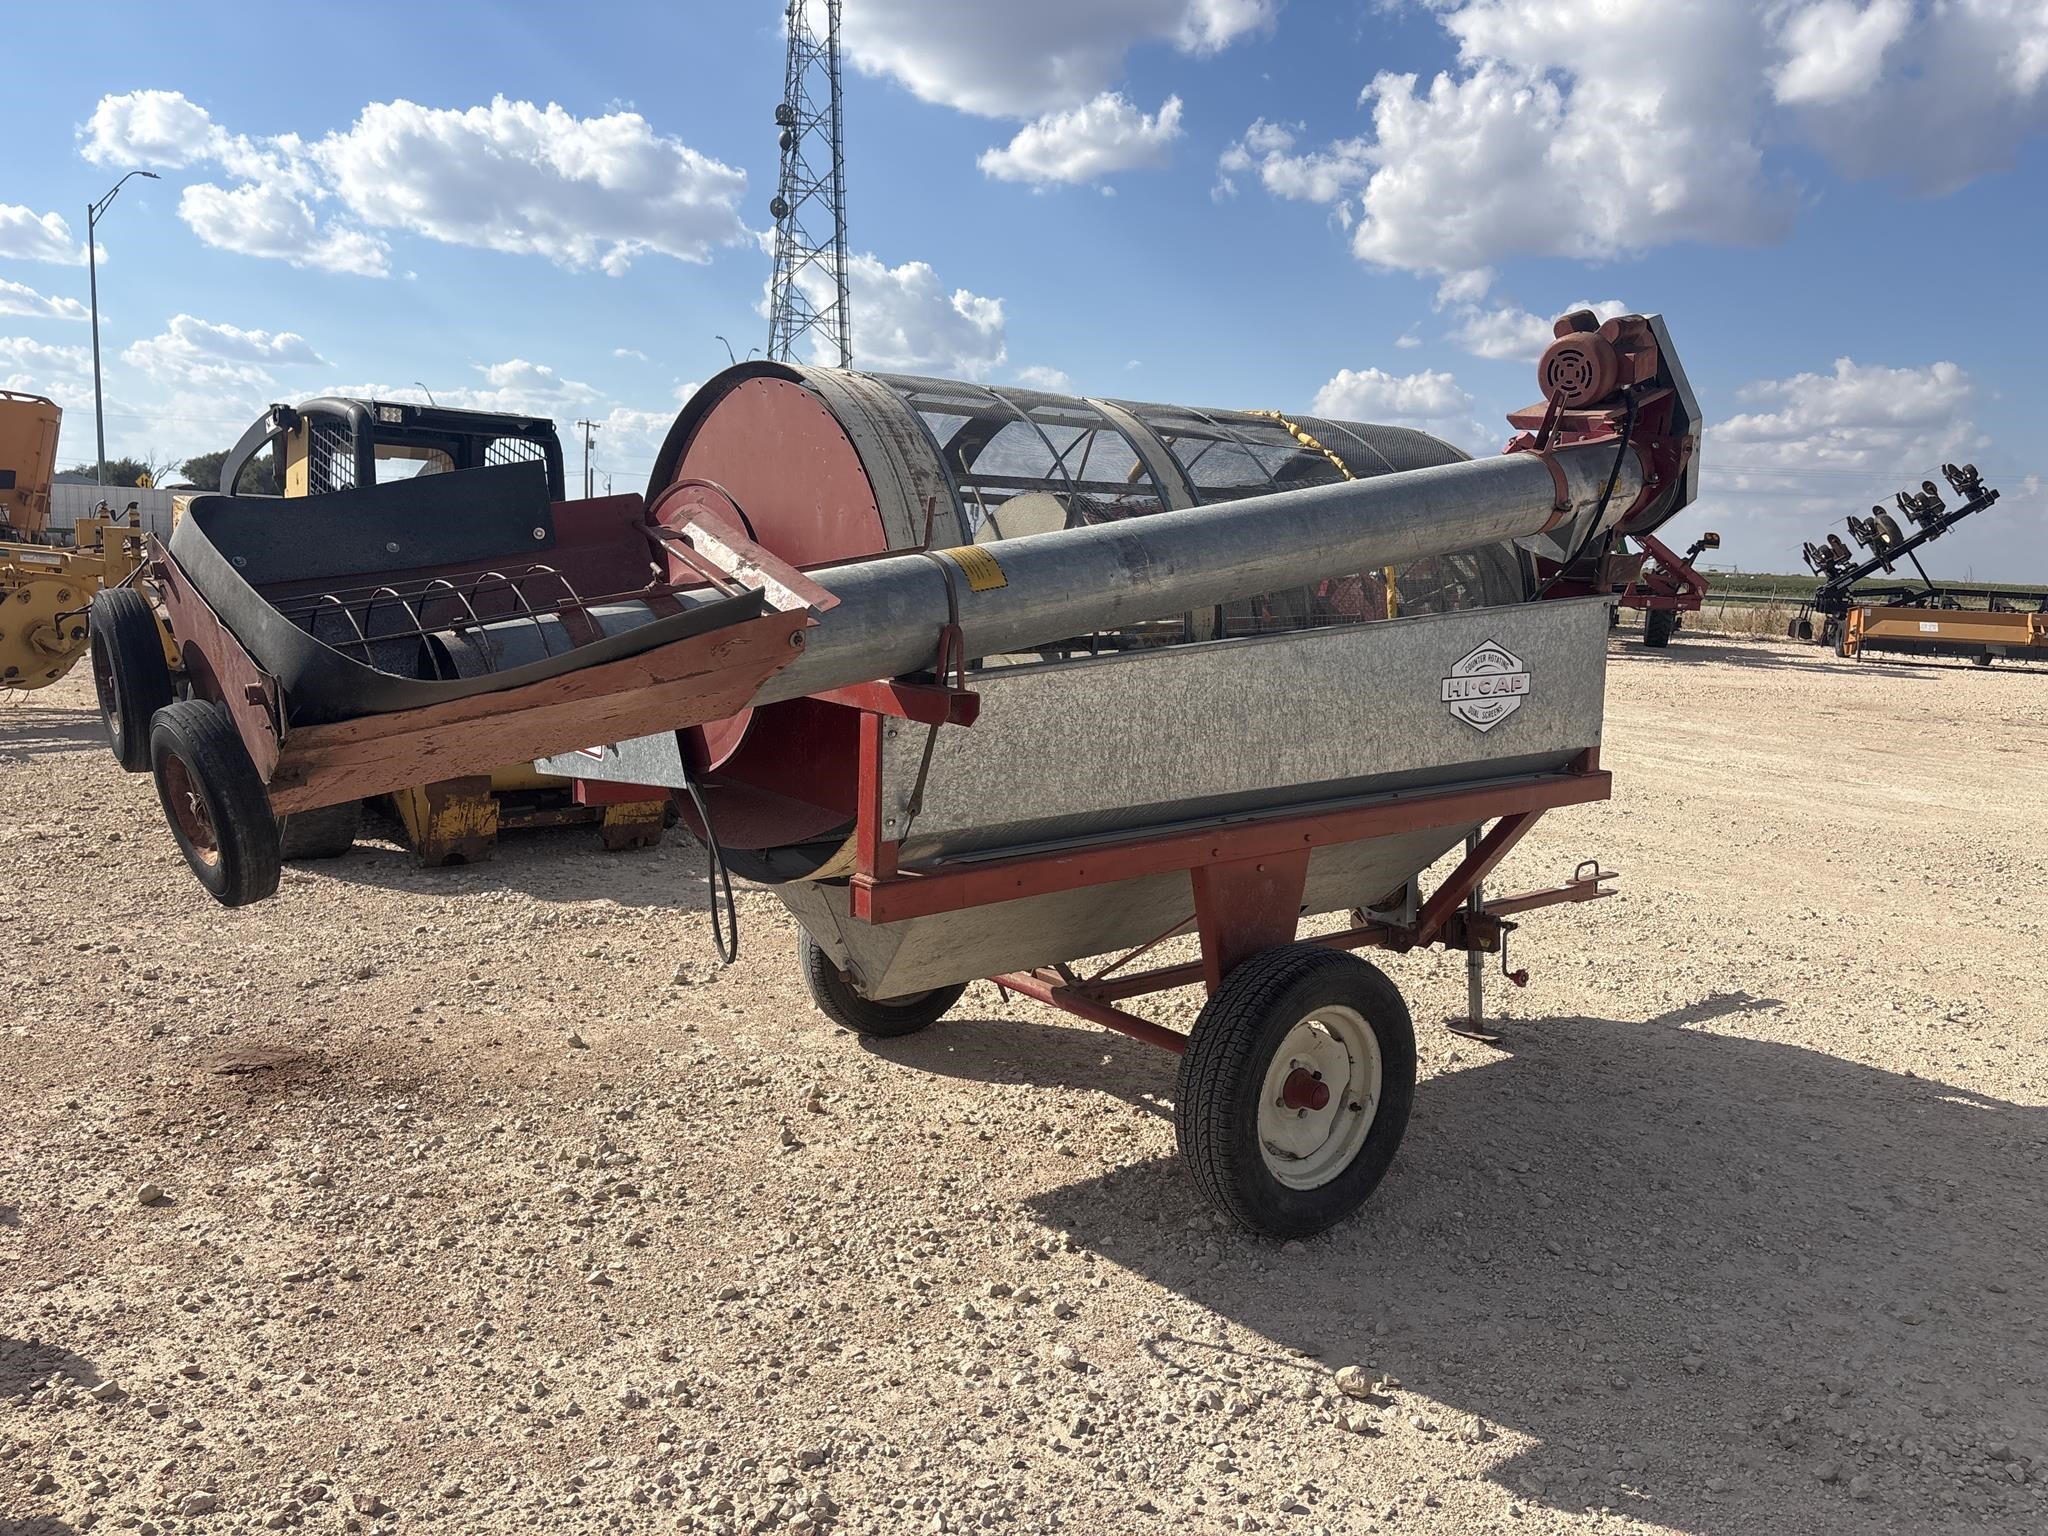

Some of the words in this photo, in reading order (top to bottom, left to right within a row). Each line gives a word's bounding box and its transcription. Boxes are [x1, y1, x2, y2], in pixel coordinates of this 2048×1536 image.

[1464, 654, 1487, 673] COUNTER
[1488, 654, 1510, 671] ROTATING
[1467, 705, 1480, 719] DUAL
[1481, 704, 1504, 720] SCREENS
